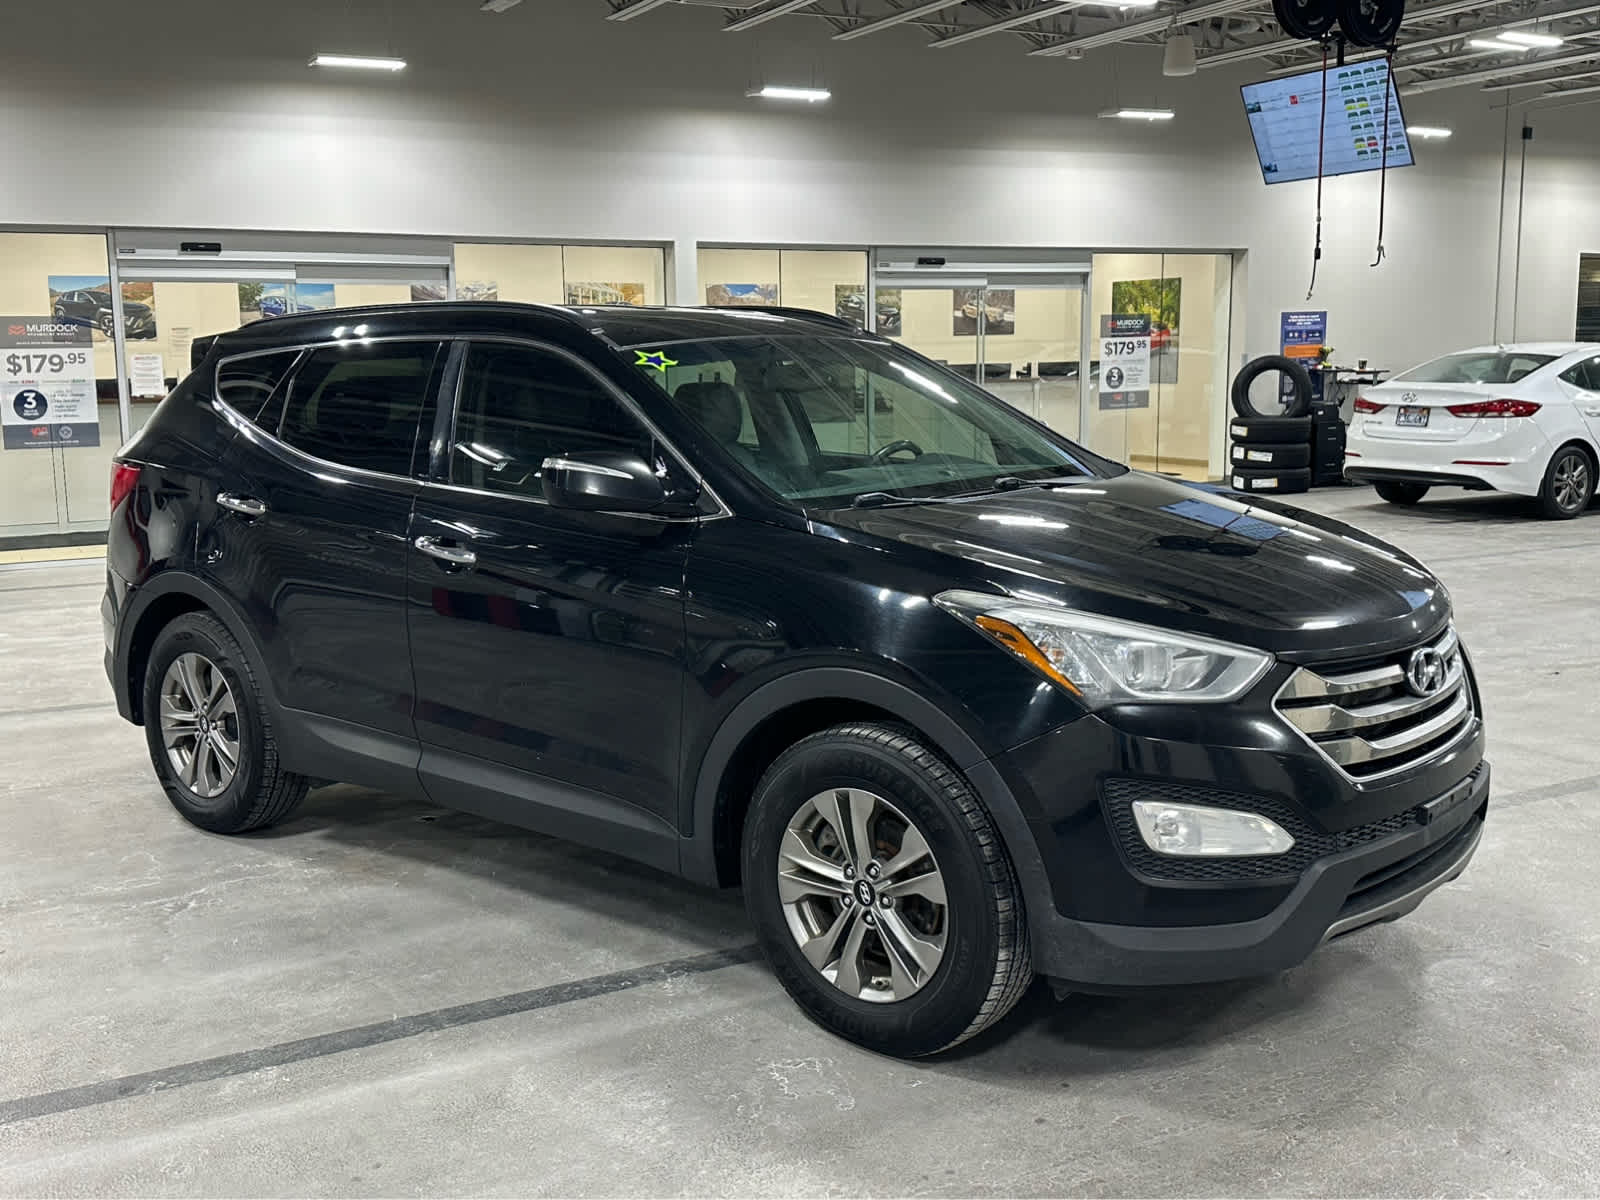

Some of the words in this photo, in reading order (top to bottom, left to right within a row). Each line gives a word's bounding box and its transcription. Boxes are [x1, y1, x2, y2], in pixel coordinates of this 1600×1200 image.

[26, 324, 78, 332] MURDOCK
[1104, 340, 1147, 356] $179.95
[6, 352, 86, 376] $179.95
[1111, 369, 1118, 381] 3
[23, 392, 37, 409] 3
